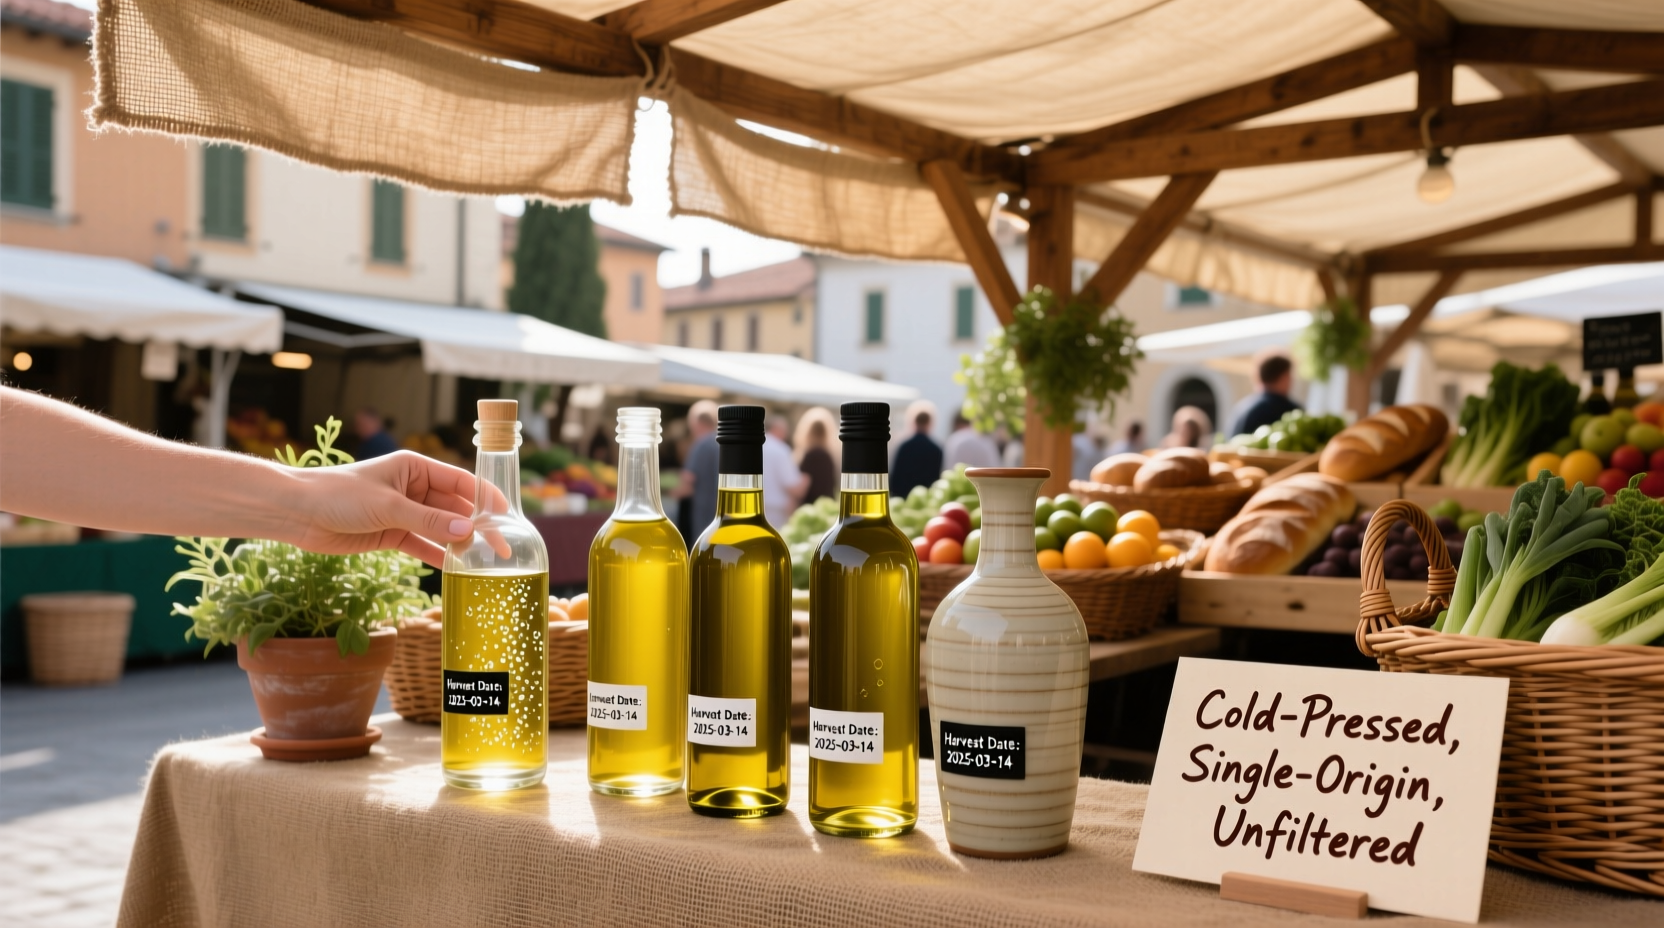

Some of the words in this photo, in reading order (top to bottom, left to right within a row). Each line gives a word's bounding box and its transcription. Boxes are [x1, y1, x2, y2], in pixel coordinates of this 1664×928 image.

[724, 709, 752, 721] Date:
[1195, 688, 1461, 756] Cold-Pressed,
[693, 722, 748, 737] 2025-03-14
[848, 723, 878, 736] Date:
[815, 737, 874, 753] 2025-03-14
[944, 731, 984, 749] Harvest
[987, 735, 1021, 751] Date:
[946, 749, 1014, 770] 2025-03-14
[1181, 743, 1445, 819] Single-Origin,
[1212, 804, 1425, 868] Unfiltered
